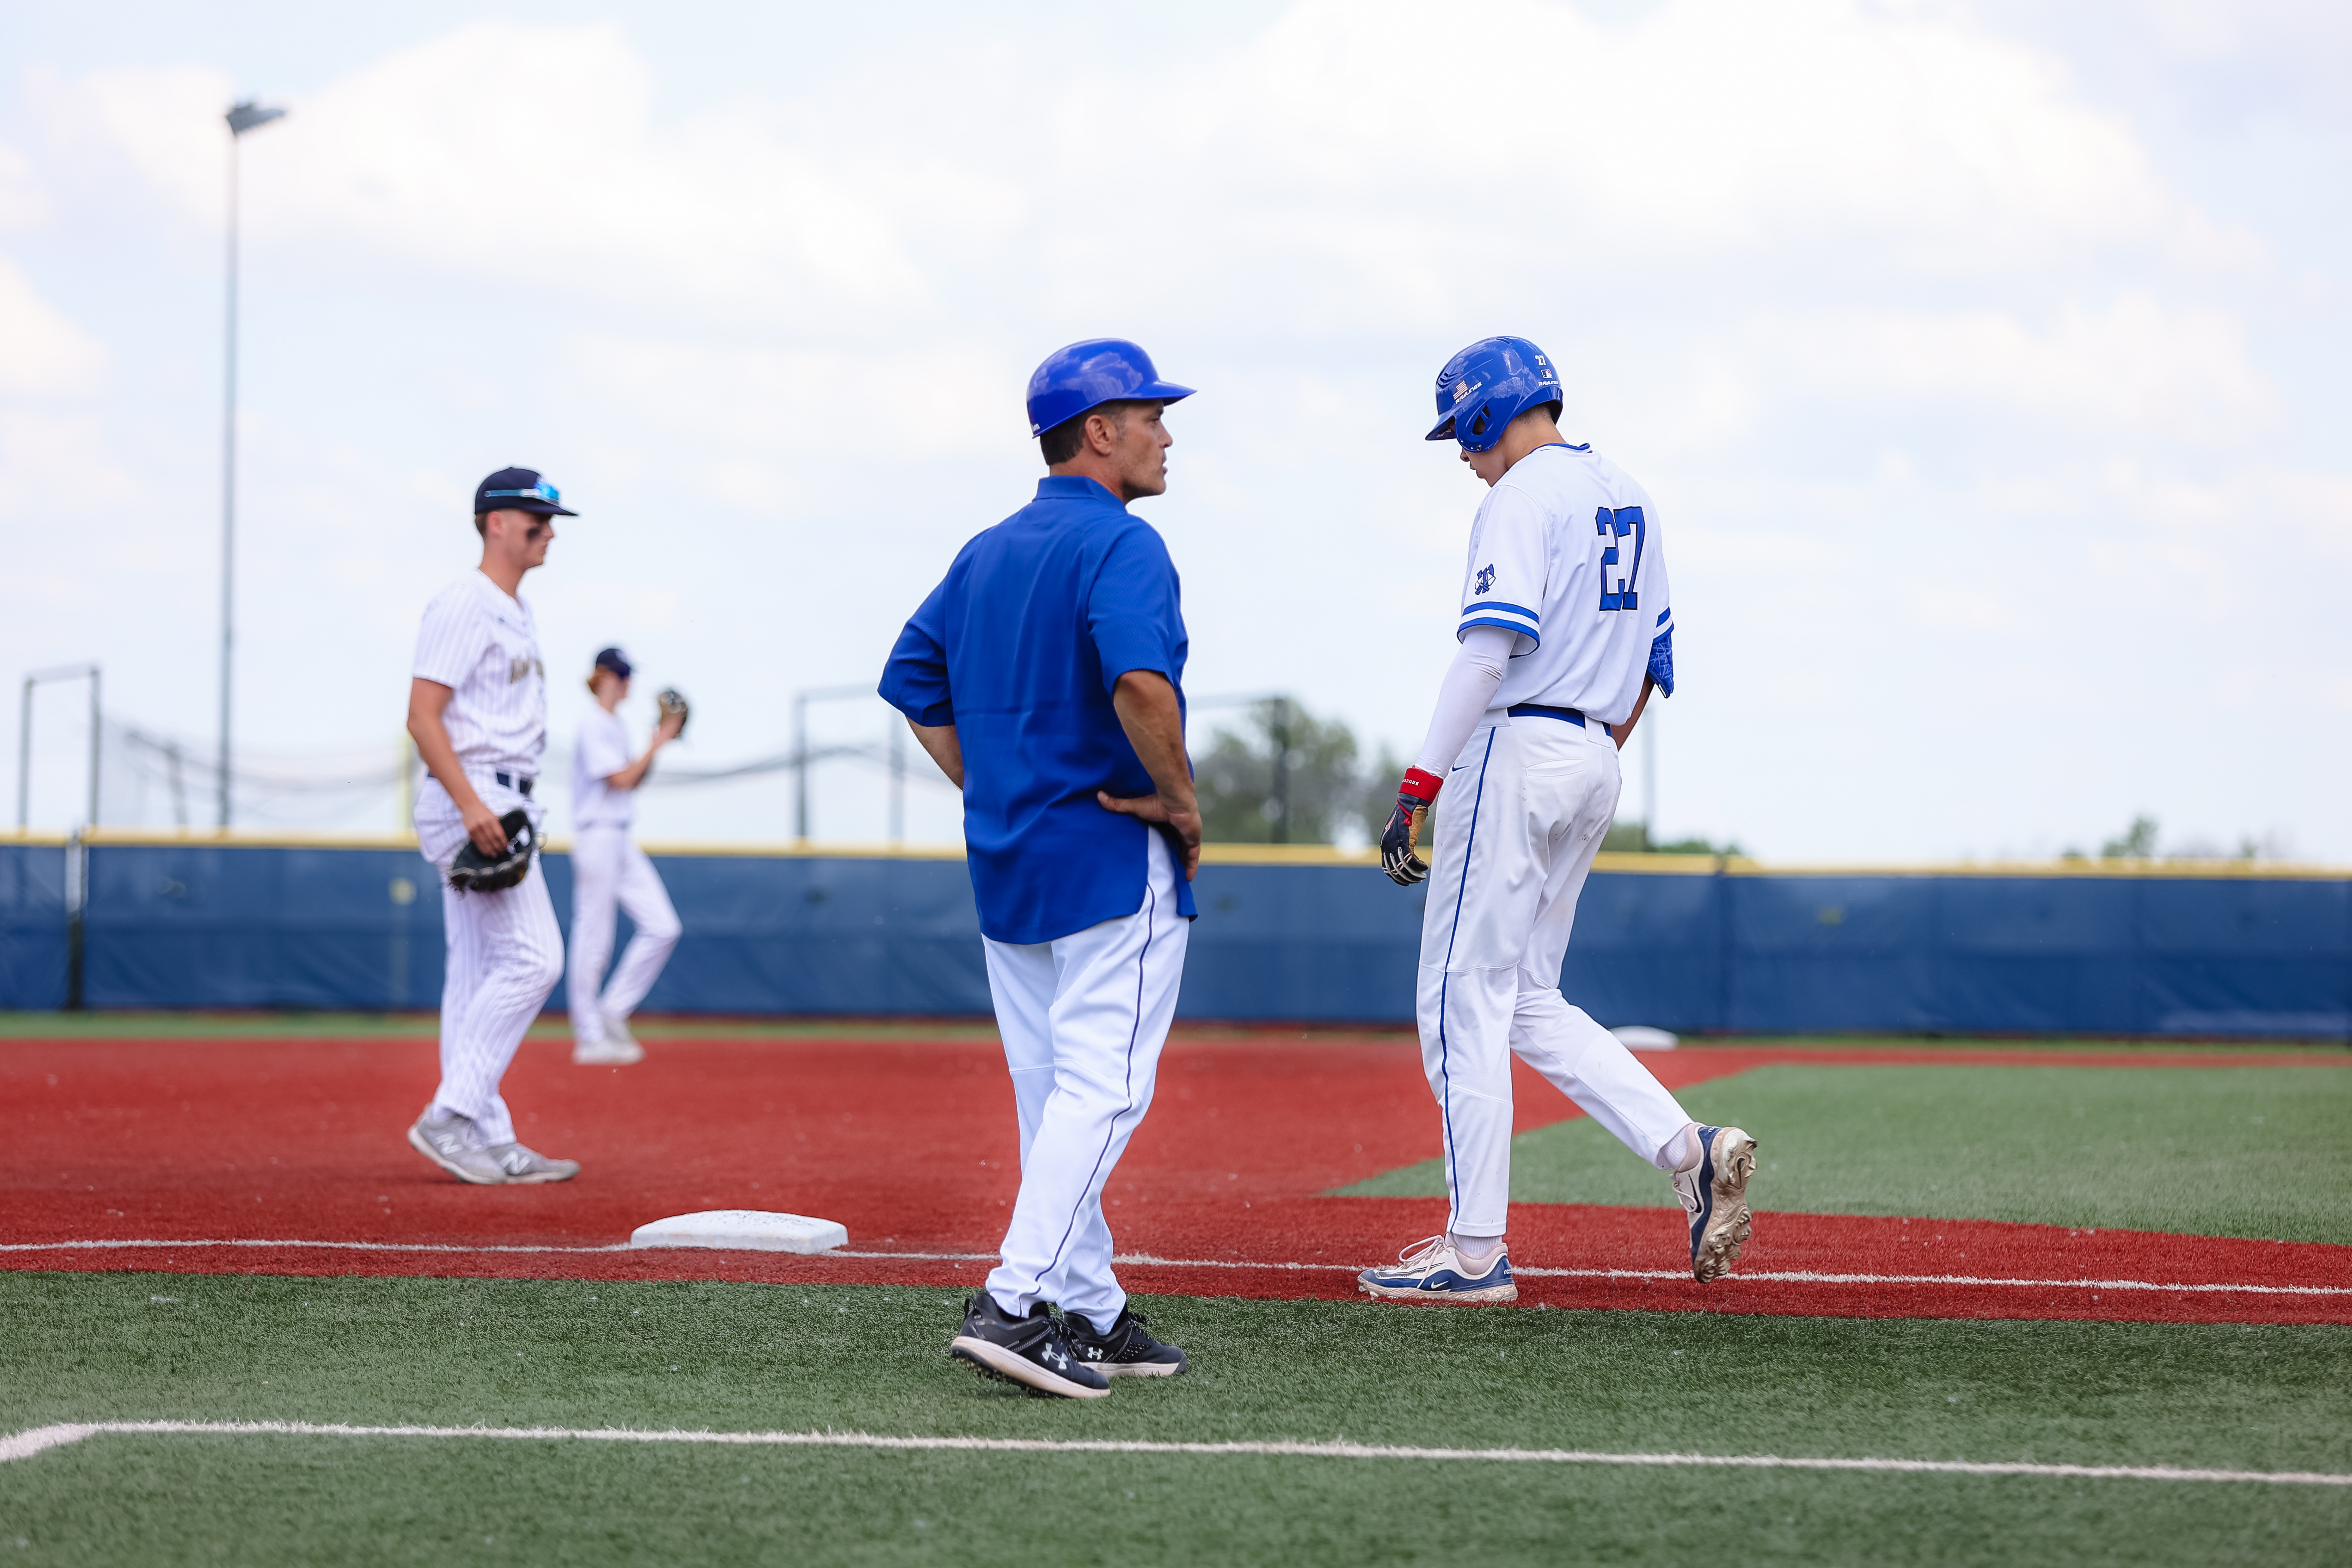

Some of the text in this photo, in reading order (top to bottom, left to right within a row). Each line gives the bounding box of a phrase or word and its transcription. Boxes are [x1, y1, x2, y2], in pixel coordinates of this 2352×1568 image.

[1534, 355, 1546, 366] 27
[1455, 382, 1482, 404] RAWLINGS
[1595, 506, 1645, 611] 27
